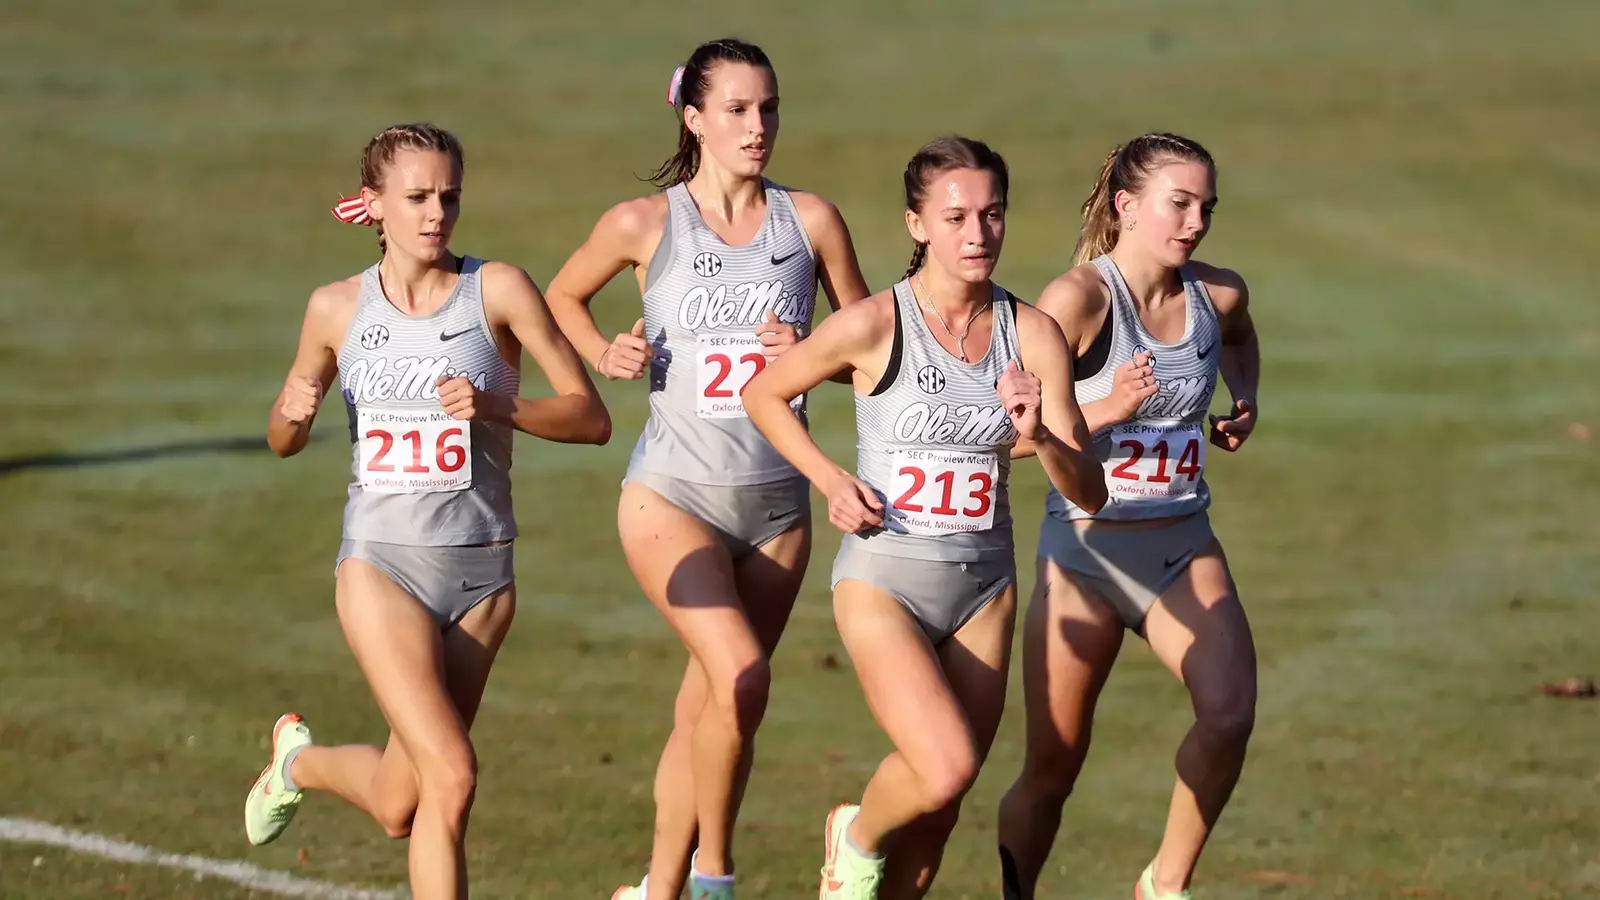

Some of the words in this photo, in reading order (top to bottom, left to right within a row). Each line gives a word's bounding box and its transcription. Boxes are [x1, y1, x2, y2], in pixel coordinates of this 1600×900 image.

[694, 252, 722, 277] SEC
[678, 285, 736, 331] Ole
[733, 280, 809, 326] Miss
[361, 324, 389, 350] SEC
[710, 337, 727, 345] SEC
[730, 337, 761, 345] Previe
[345, 357, 395, 405] Ole
[703, 353, 768, 398] 22
[917, 365, 945, 394] SEC
[1135, 379, 1166, 419] le
[370, 413, 386, 422] SEC
[389, 414, 427, 423] Preview
[430, 413, 452, 422] Mee
[894, 402, 955, 445] Ole
[1123, 425, 1139, 433] SEC
[366, 428, 466, 473] 216
[907, 451, 924, 460] SEC
[928, 453, 964, 464] Preview
[967, 456, 990, 465] Meet
[1111, 439, 1200, 482] 214
[375, 478, 406, 488] Oxford,
[409, 478, 458, 487] Mississippi
[893, 466, 992, 518] 213
[1116, 484, 1147, 495] Oxford,
[900, 516, 932, 529] Oxford,
[935, 518, 980, 530] Mississippi
